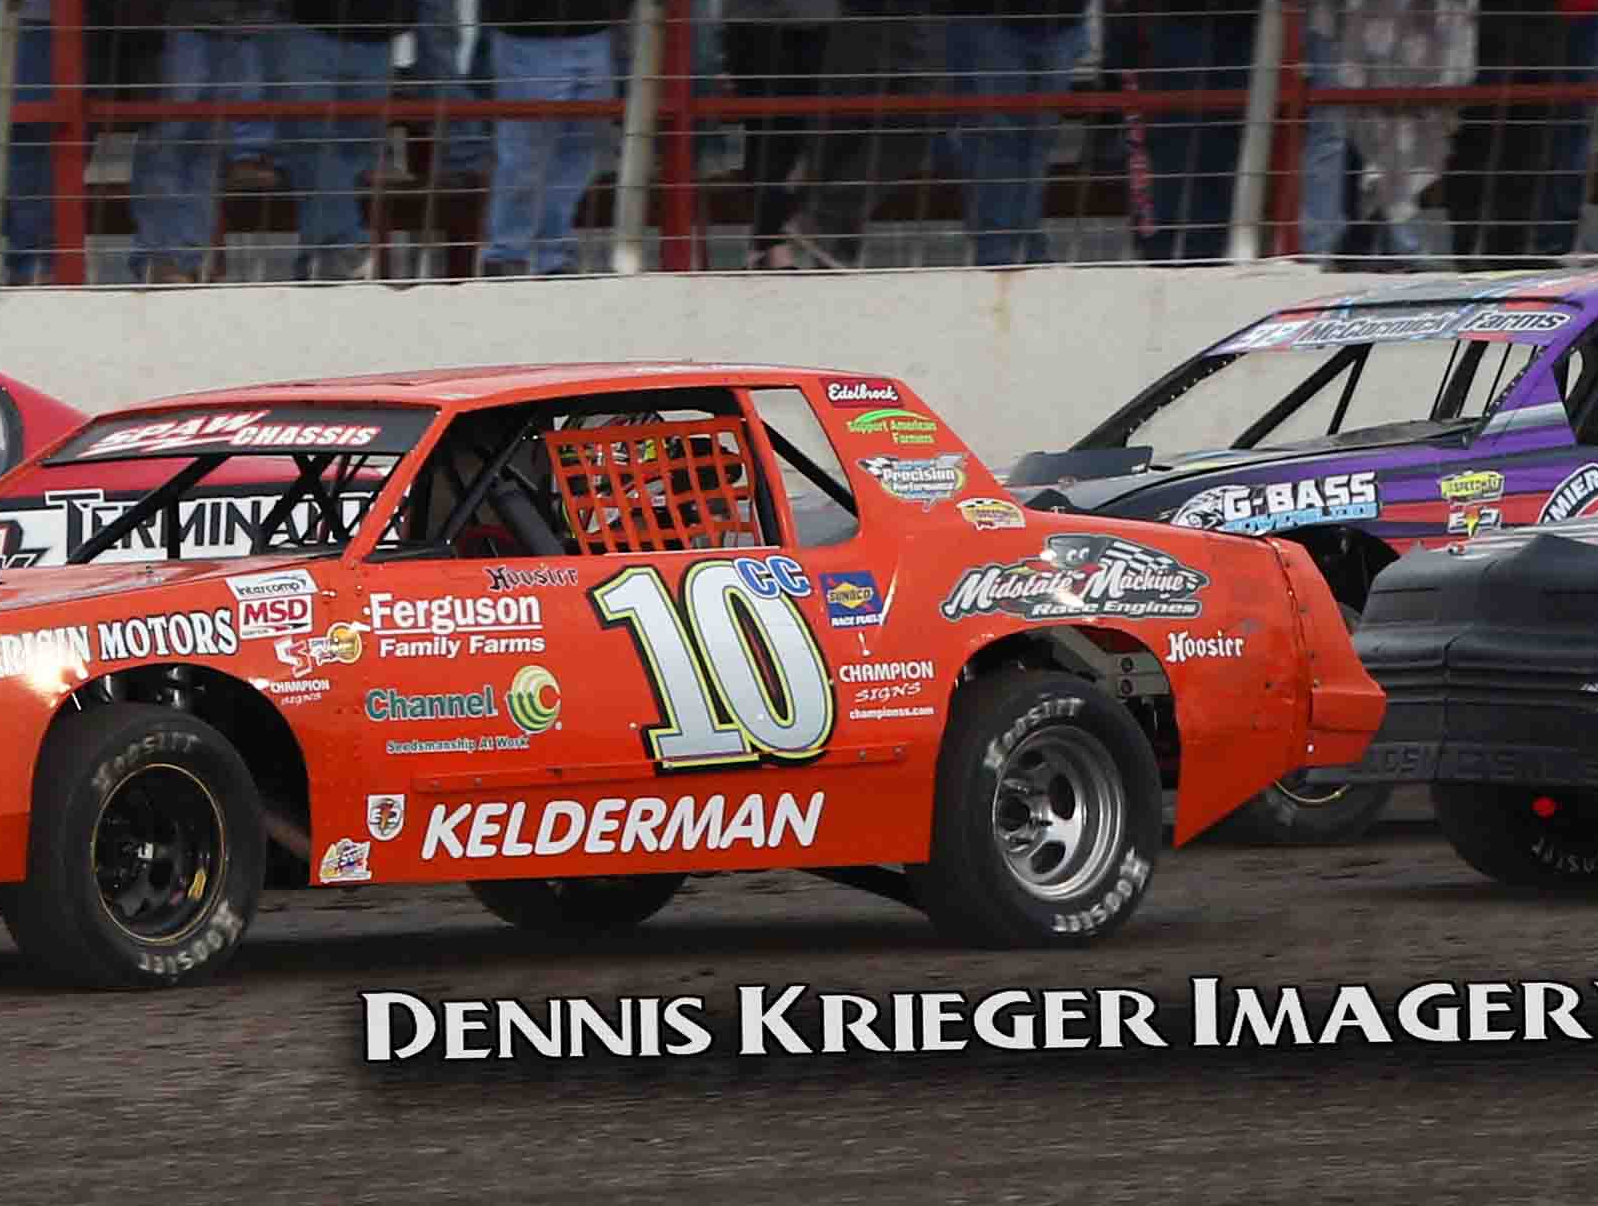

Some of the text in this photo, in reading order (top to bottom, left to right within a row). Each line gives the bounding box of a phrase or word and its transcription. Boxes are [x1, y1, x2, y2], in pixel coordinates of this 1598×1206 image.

[1462, 311, 1569, 330] Farms
[827, 383, 899, 402] Edelbrock
[230, 425, 380, 446] CHASSIS
[1222, 472, 1377, 522] G-BASS
[45, 488, 410, 558] TERMINA
[235, 580, 301, 596] Intercomp
[827, 587, 874, 603] SUNOCO
[943, 560, 1186, 616] Midstate Machine
[243, 598, 308, 625] MSD
[369, 593, 542, 634] Ferguson
[1030, 598, 1200, 617] Race Engines
[97, 608, 239, 662] MOTORS
[379, 638, 461, 659] Family
[468, 634, 546, 655] Farms
[1165, 630, 1246, 663] Hoosier
[592, 558, 835, 772] 10
[838, 660, 936, 683] CHAMPION
[365, 685, 499, 722] Channel
[420, 790, 826, 861] KELDERMAN
